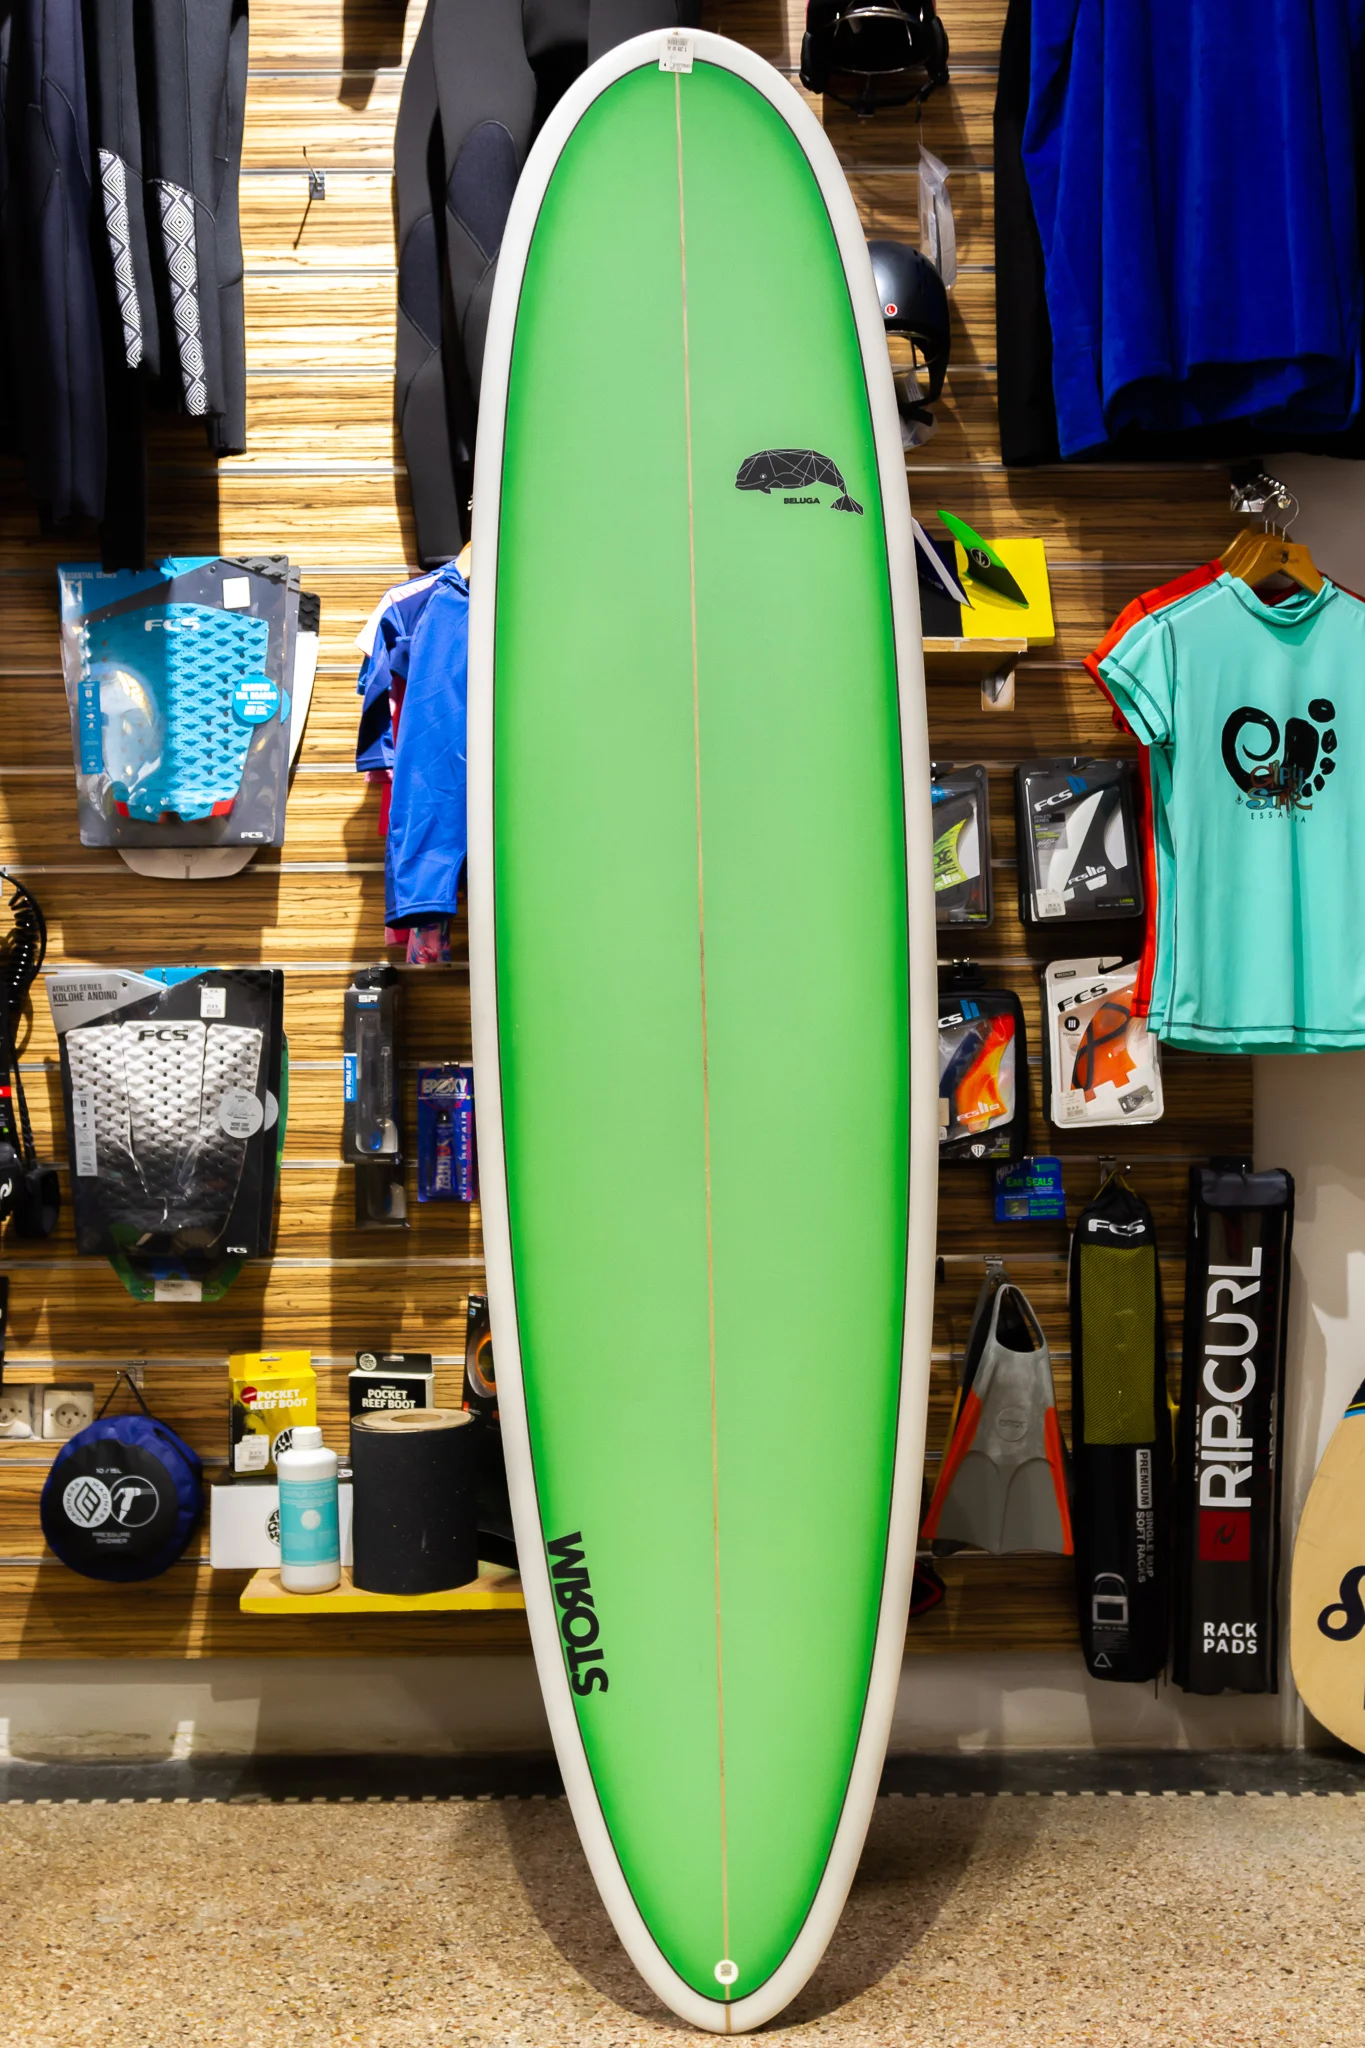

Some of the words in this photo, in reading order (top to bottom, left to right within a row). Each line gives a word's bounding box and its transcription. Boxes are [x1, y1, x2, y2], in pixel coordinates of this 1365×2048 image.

[784, 497, 820, 505] BELUGA
[144, 617, 201, 632] FCS
[240, 831, 264, 839] FCS
[52, 984, 77, 992] ATHLETE
[79, 983, 102, 991] SERIES
[52, 992, 85, 1002] KOLOHE
[87, 990, 118, 1001] ANDINO
[1057, 983, 1109, 1013] FCS
[938, 1013, 964, 1029] CS
[138, 1029, 189, 1042] FCS
[422, 1078, 468, 1094] EPOXY
[460, 1111, 468, 1160] REPAIR
[1026, 1176, 1054, 1187] SEALS
[1088, 1218, 1146, 1237] FCS
[227, 1246, 248, 1254] FCS
[256, 1389, 300, 1401] POCKET
[367, 1388, 408, 1399] POCKET
[250, 1400, 278, 1410] REEF
[278, 1398, 308, 1409] BOOT
[361, 1398, 386, 1408] REEF
[387, 1399, 416, 1409] BOOT
[1140, 1451, 1149, 1506] PREMIUM
[1136, 1511, 1145, 1539] SOFT
[1146, 1511, 1155, 1552] SINGLE
[547, 1530, 609, 1697] STORM
[1203, 1622, 1257, 1637] RACK
[1203, 1638, 1258, 1654] PADS
